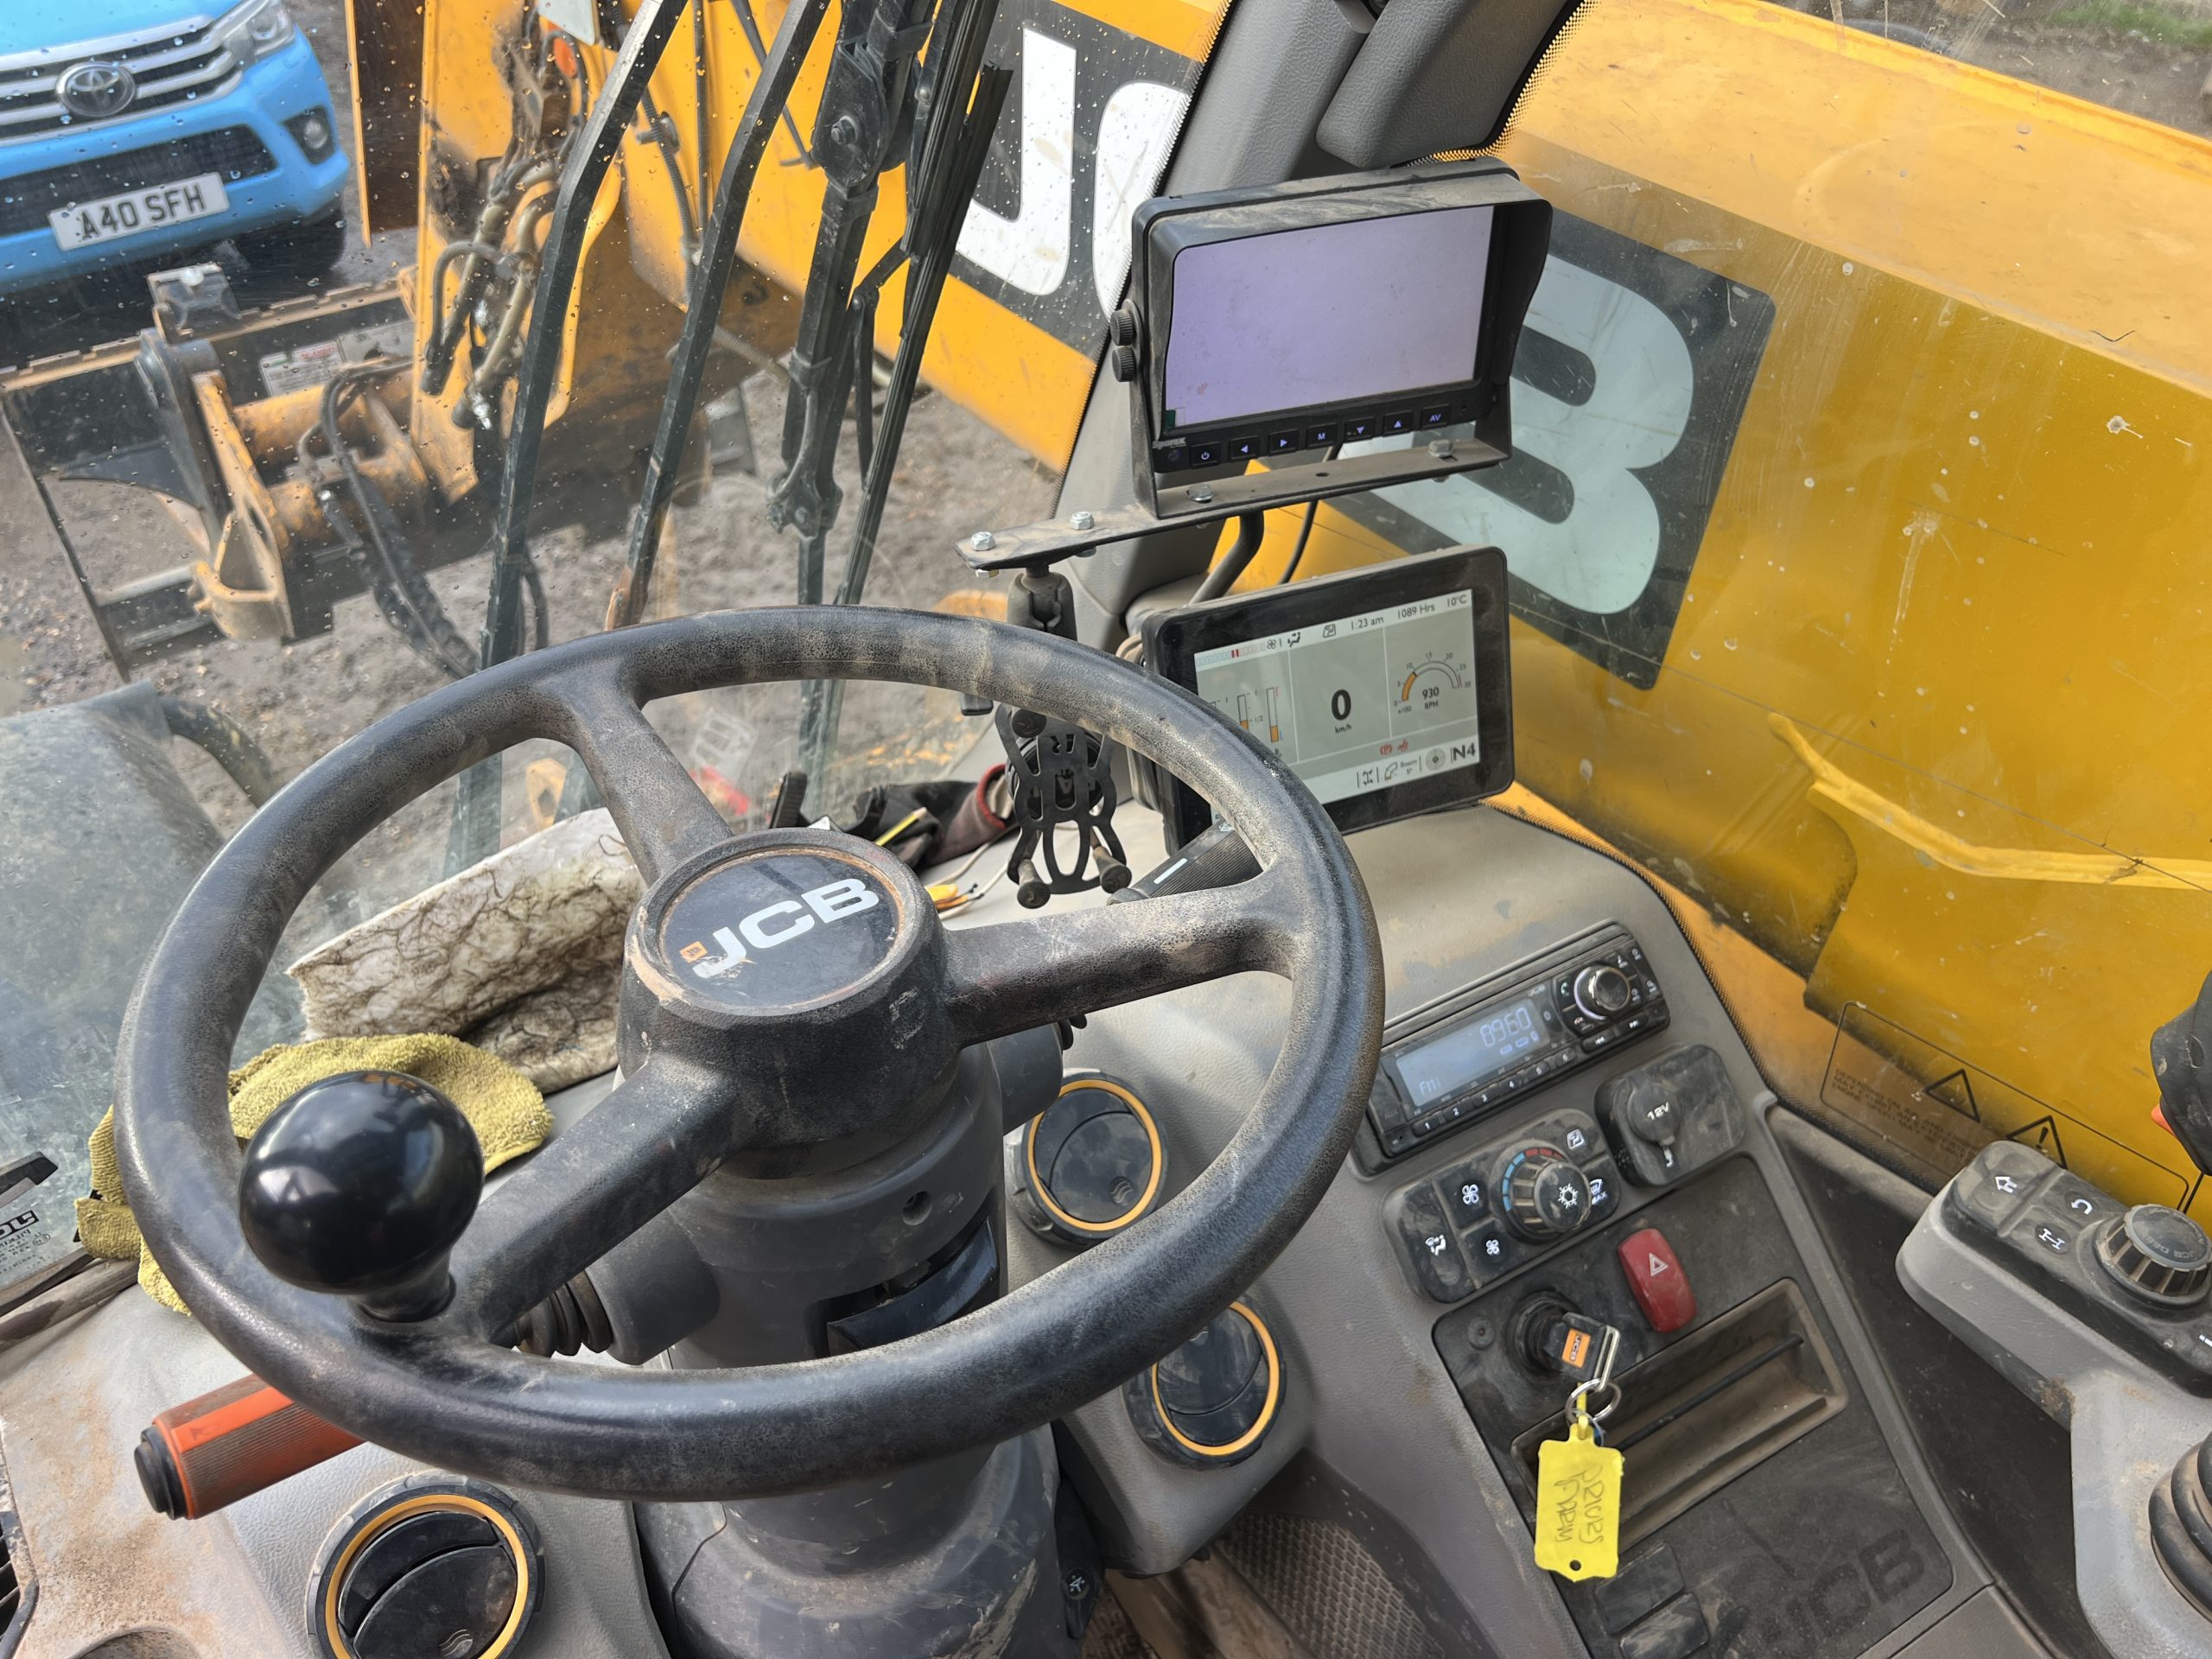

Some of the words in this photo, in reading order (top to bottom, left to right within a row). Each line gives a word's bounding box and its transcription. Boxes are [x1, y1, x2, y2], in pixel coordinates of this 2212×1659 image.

[81, 201, 139, 241] A40
[144, 182, 207, 222] SFH
[1429, 413, 1442, 423] AV
[1317, 431, 1326, 441] M
[1396, 607, 1418, 620] 1089
[1419, 603, 1436, 614] Hrs
[1351, 619, 1369, 631] 1:23
[1370, 616, 1385, 626] am
[1421, 686, 1440, 699] 930
[1331, 689, 1352, 721] 0
[1424, 700, 1440, 711] RPM
[1334, 723, 1352, 734] km/h
[692, 878, 880, 979] JCB
[1425, 1122, 1431, 1130] 1
[1452, 1107, 1460, 1116] 2
[1481, 1094, 1488, 1103] 3
[1509, 1080, 1516, 1089] 4
[1646, 1101, 1670, 1121] 12V
[1569, 1334, 1581, 1363] JCB
